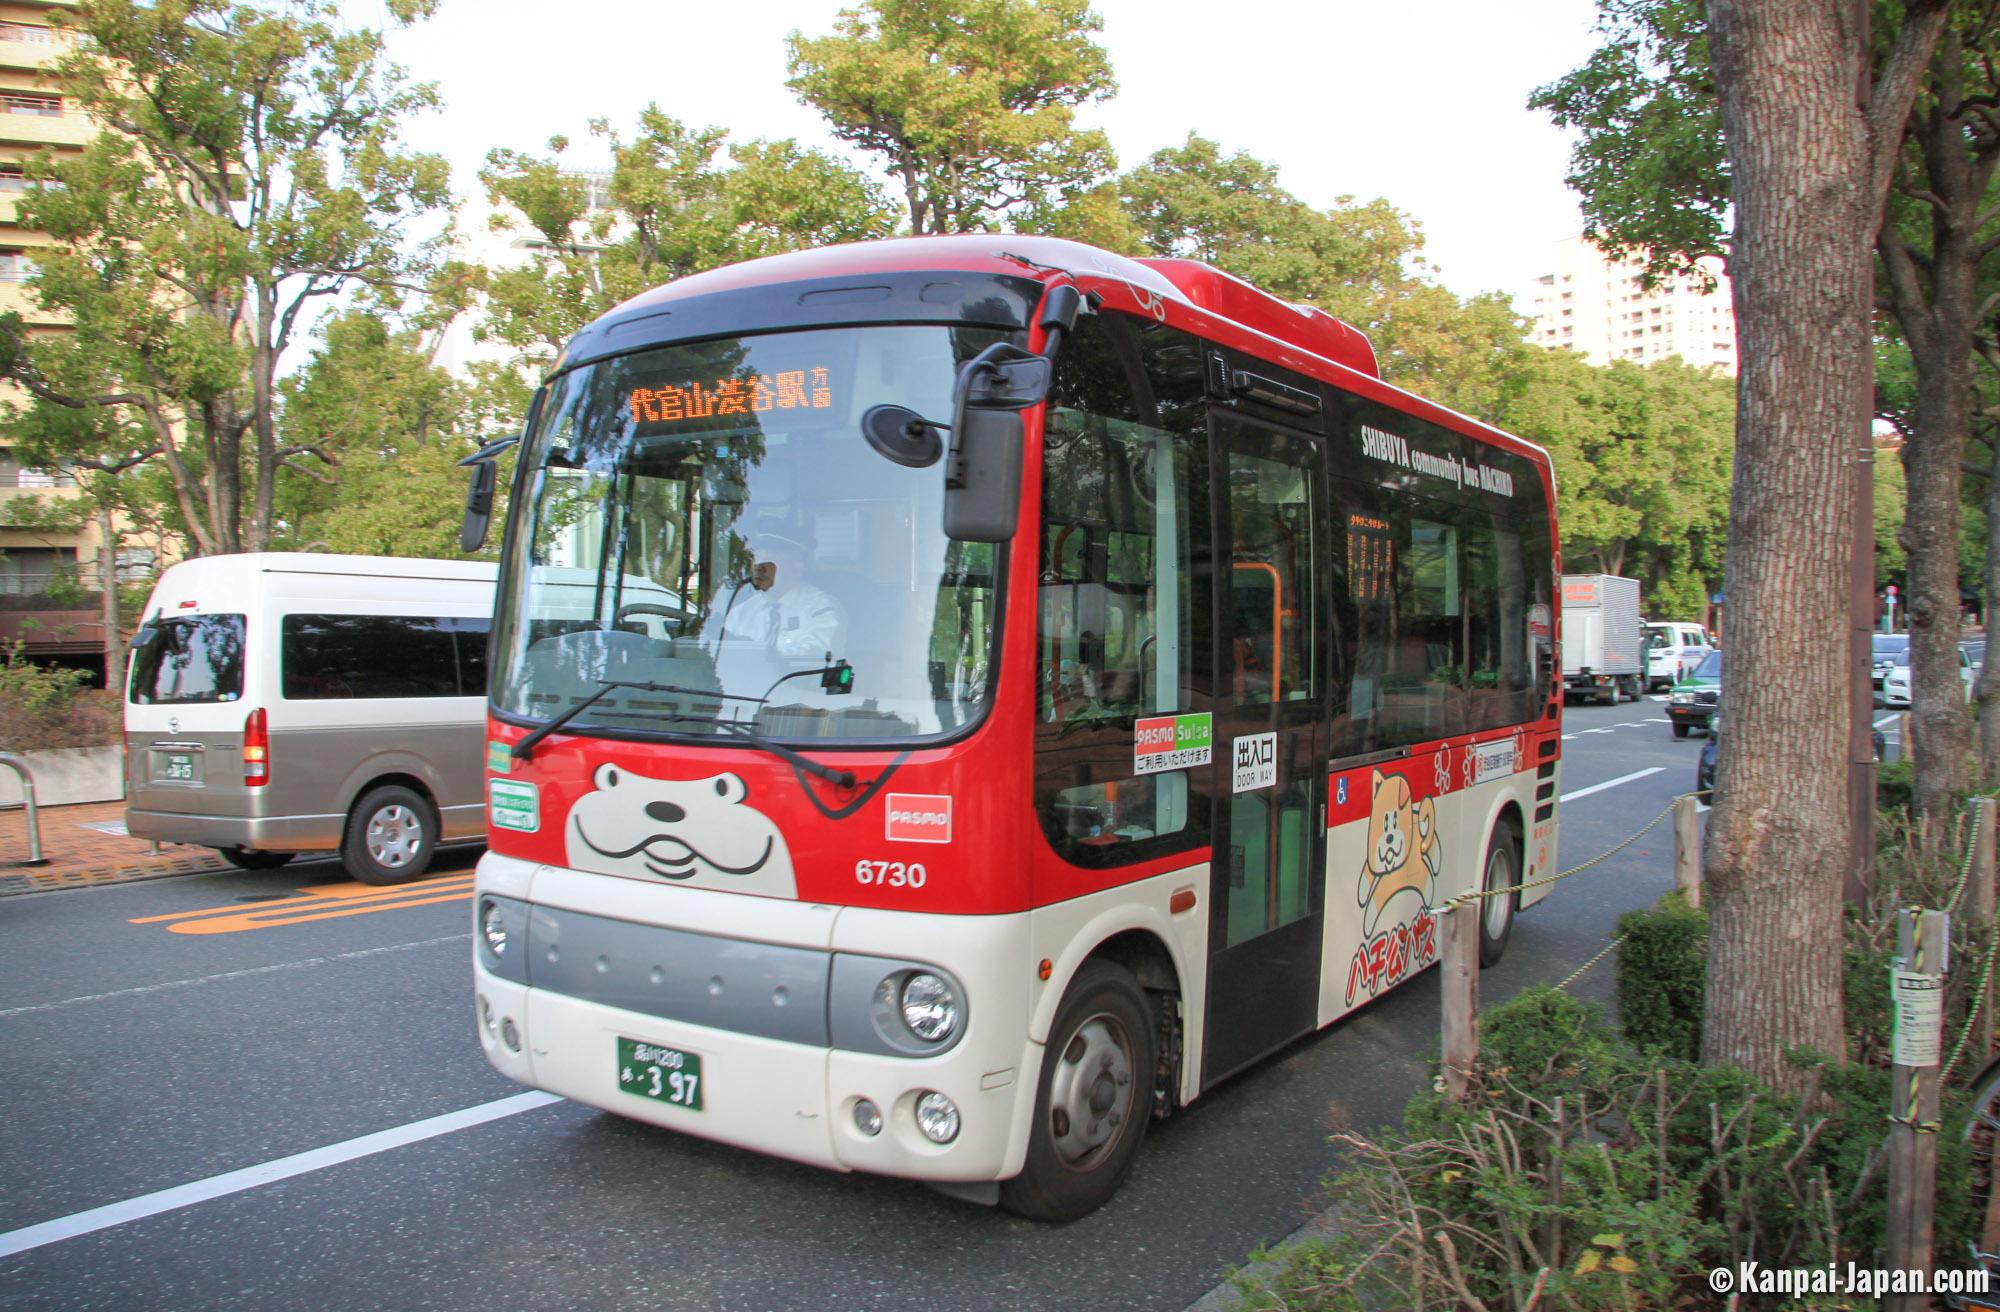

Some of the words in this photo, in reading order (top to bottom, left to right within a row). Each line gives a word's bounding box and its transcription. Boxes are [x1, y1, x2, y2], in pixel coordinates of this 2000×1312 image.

[1361, 424, 1410, 468] SHIBUYA
[1411, 449, 1462, 490] community
[1462, 457, 1480, 488] bus
[1137, 725, 1174, 745] PASMO
[1177, 723, 1209, 740] Suica
[1136, 748, 1210, 770] ご利用いただけます
[1237, 737, 1274, 769] 出入口
[1237, 772, 1256, 788] DOOR
[1260, 769, 1273, 782] WAY
[890, 811, 948, 826] PASMO
[855, 859, 927, 889] 6730
[1346, 907, 1437, 1006] ハチ公バス
